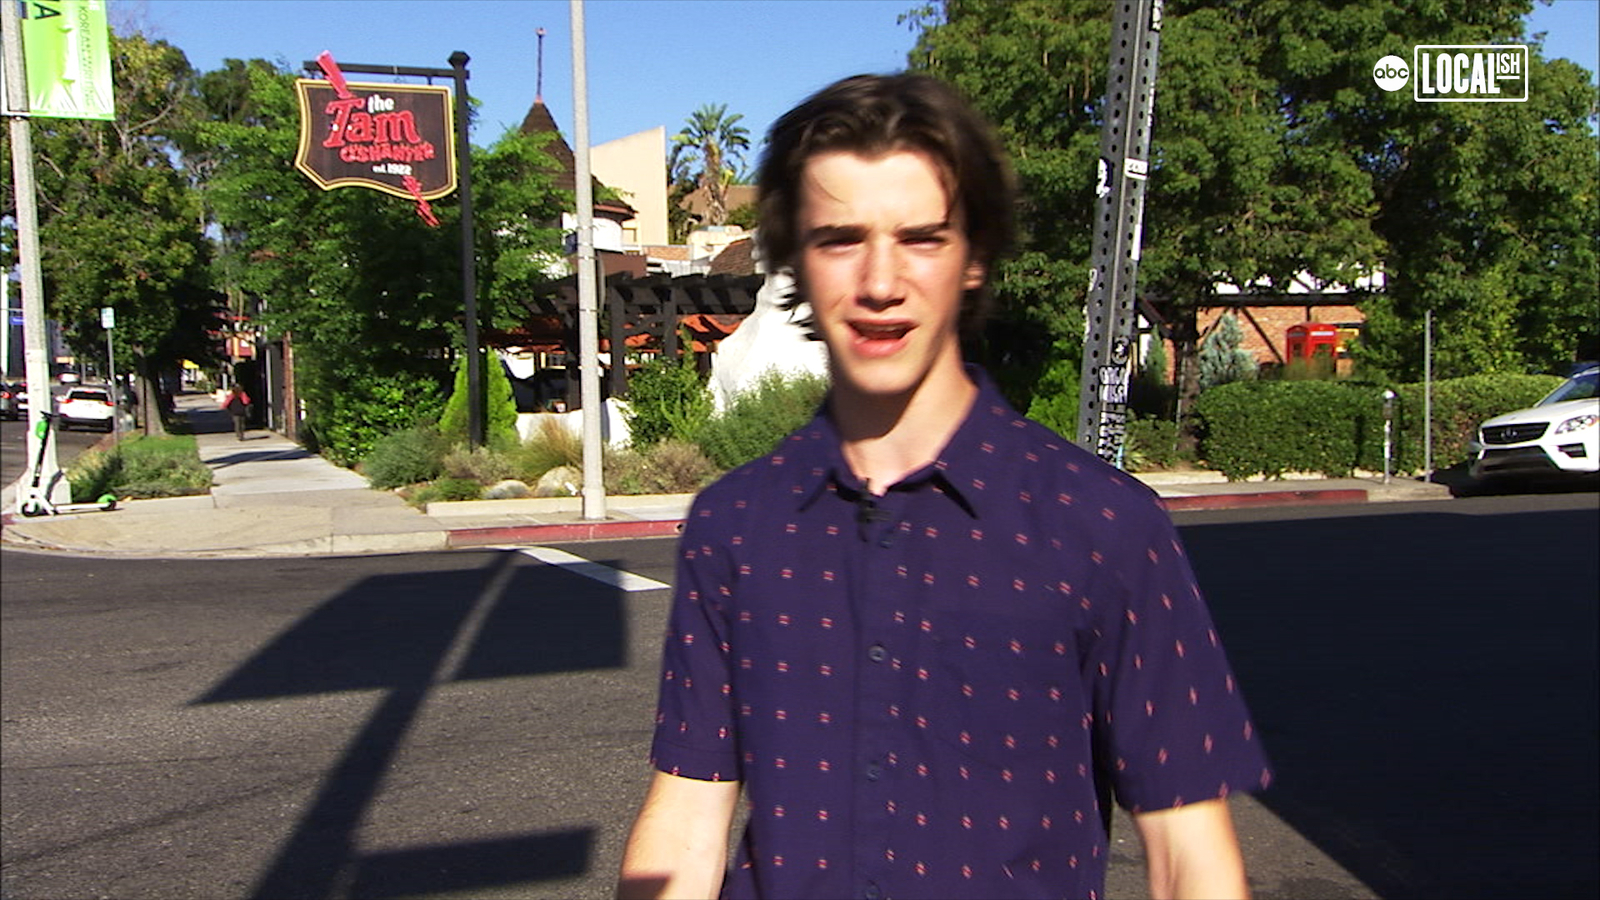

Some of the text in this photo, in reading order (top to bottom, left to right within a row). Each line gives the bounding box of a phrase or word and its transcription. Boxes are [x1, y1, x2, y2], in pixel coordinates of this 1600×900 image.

[367, 94, 395, 113] the
[323, 97, 420, 148] Tam
[387, 163, 412, 175] 1922
